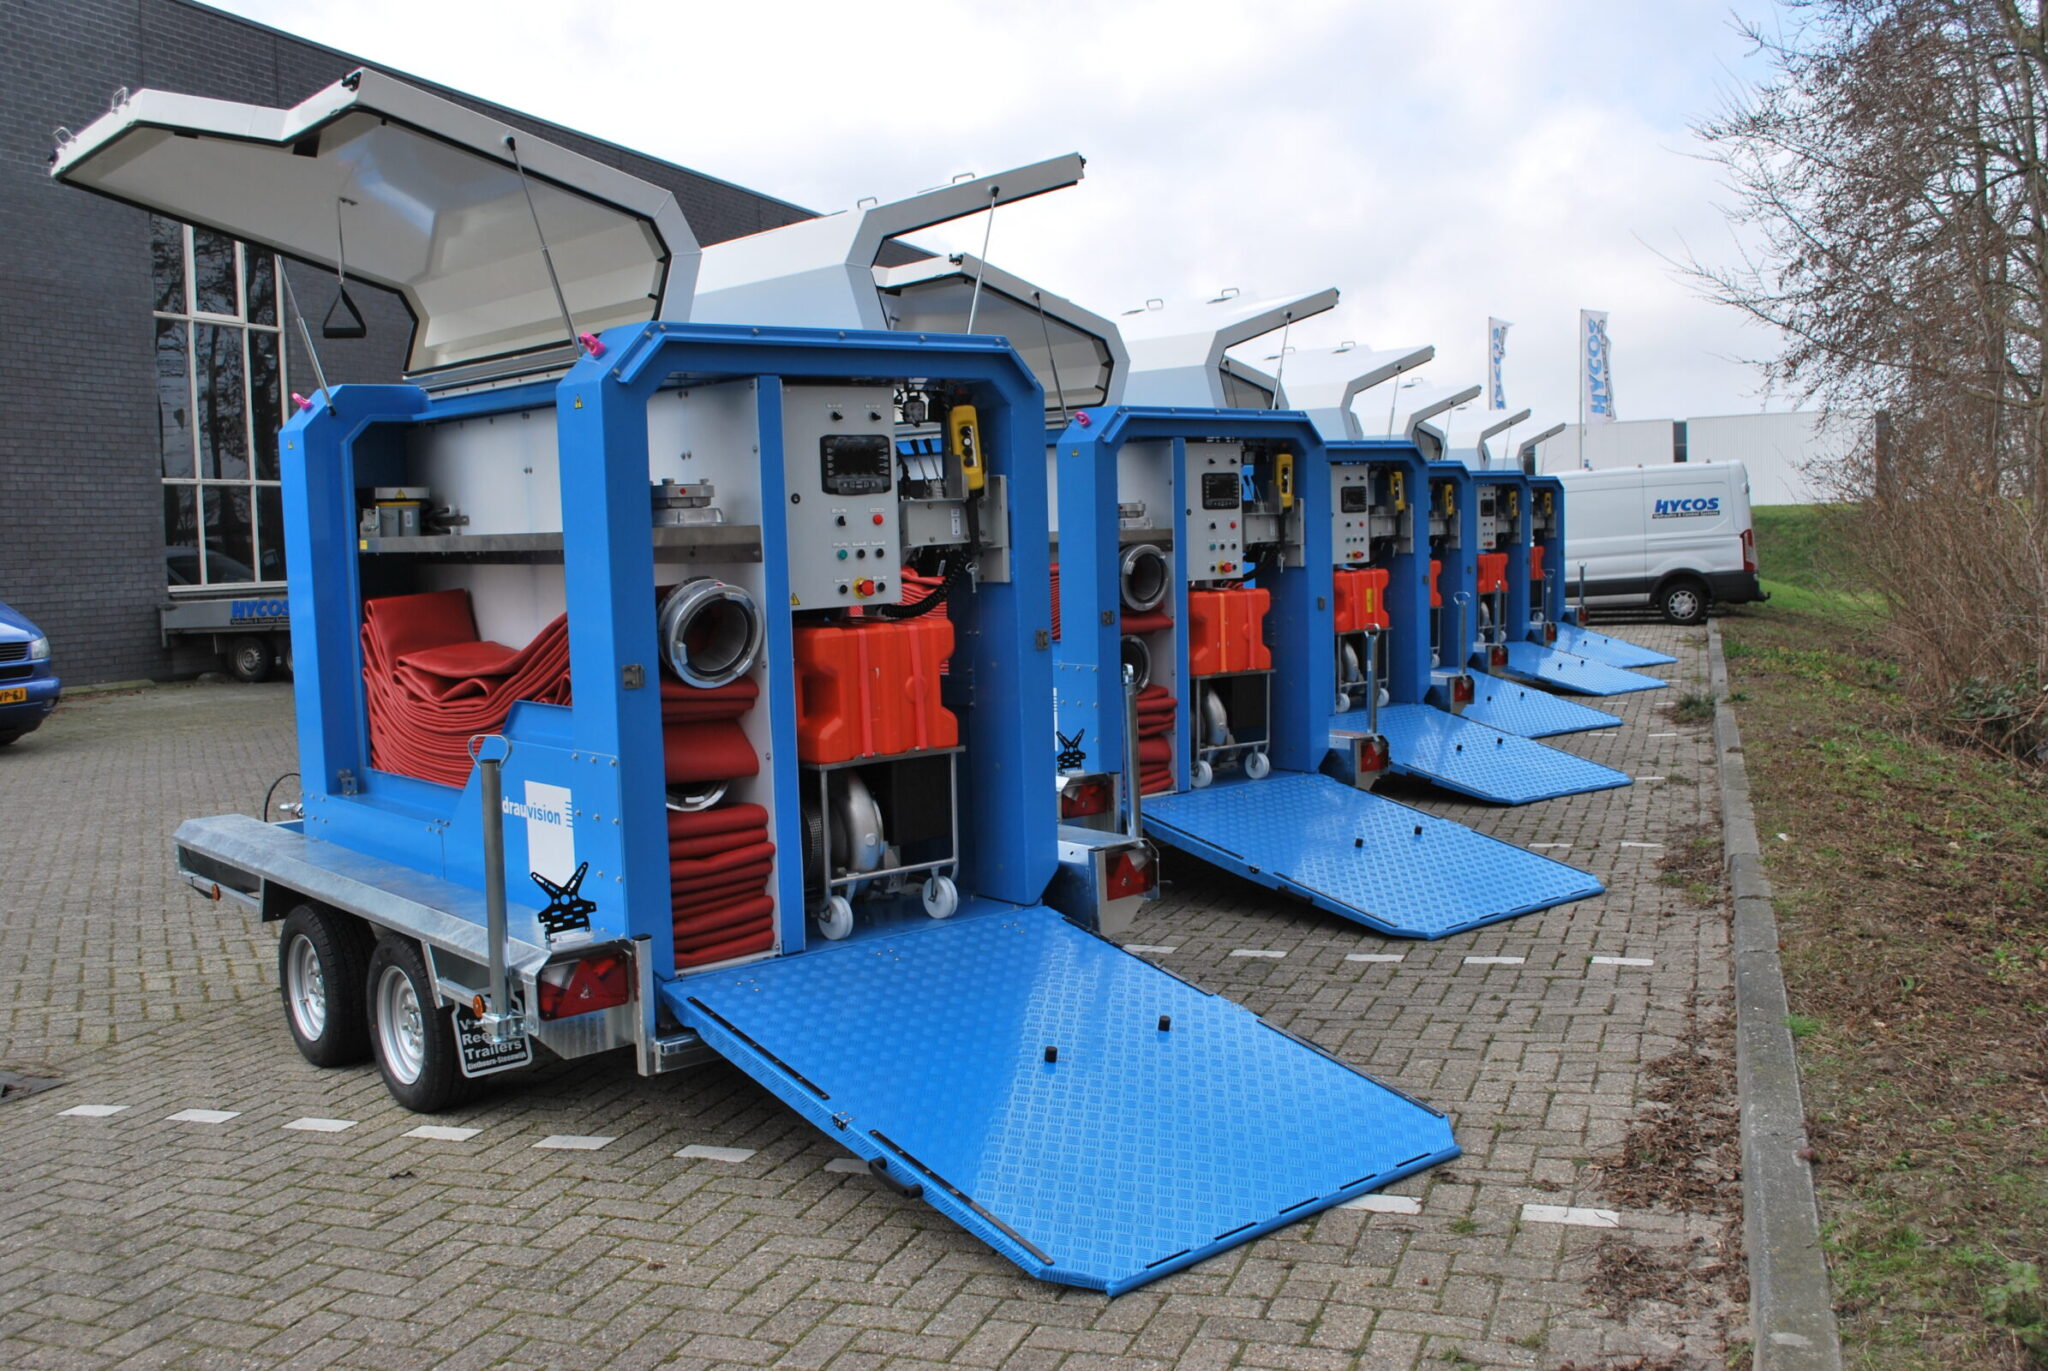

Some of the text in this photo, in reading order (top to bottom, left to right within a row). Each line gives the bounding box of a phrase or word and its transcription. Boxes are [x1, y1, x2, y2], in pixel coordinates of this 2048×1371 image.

[1587, 318, 1607, 414] HYCOS
[1654, 497, 1719, 514] HYCOS
[231, 599, 290, 618] HYCOS
[502, 796, 561, 825] drauvision
[465, 1040, 522, 1060] Trailers
